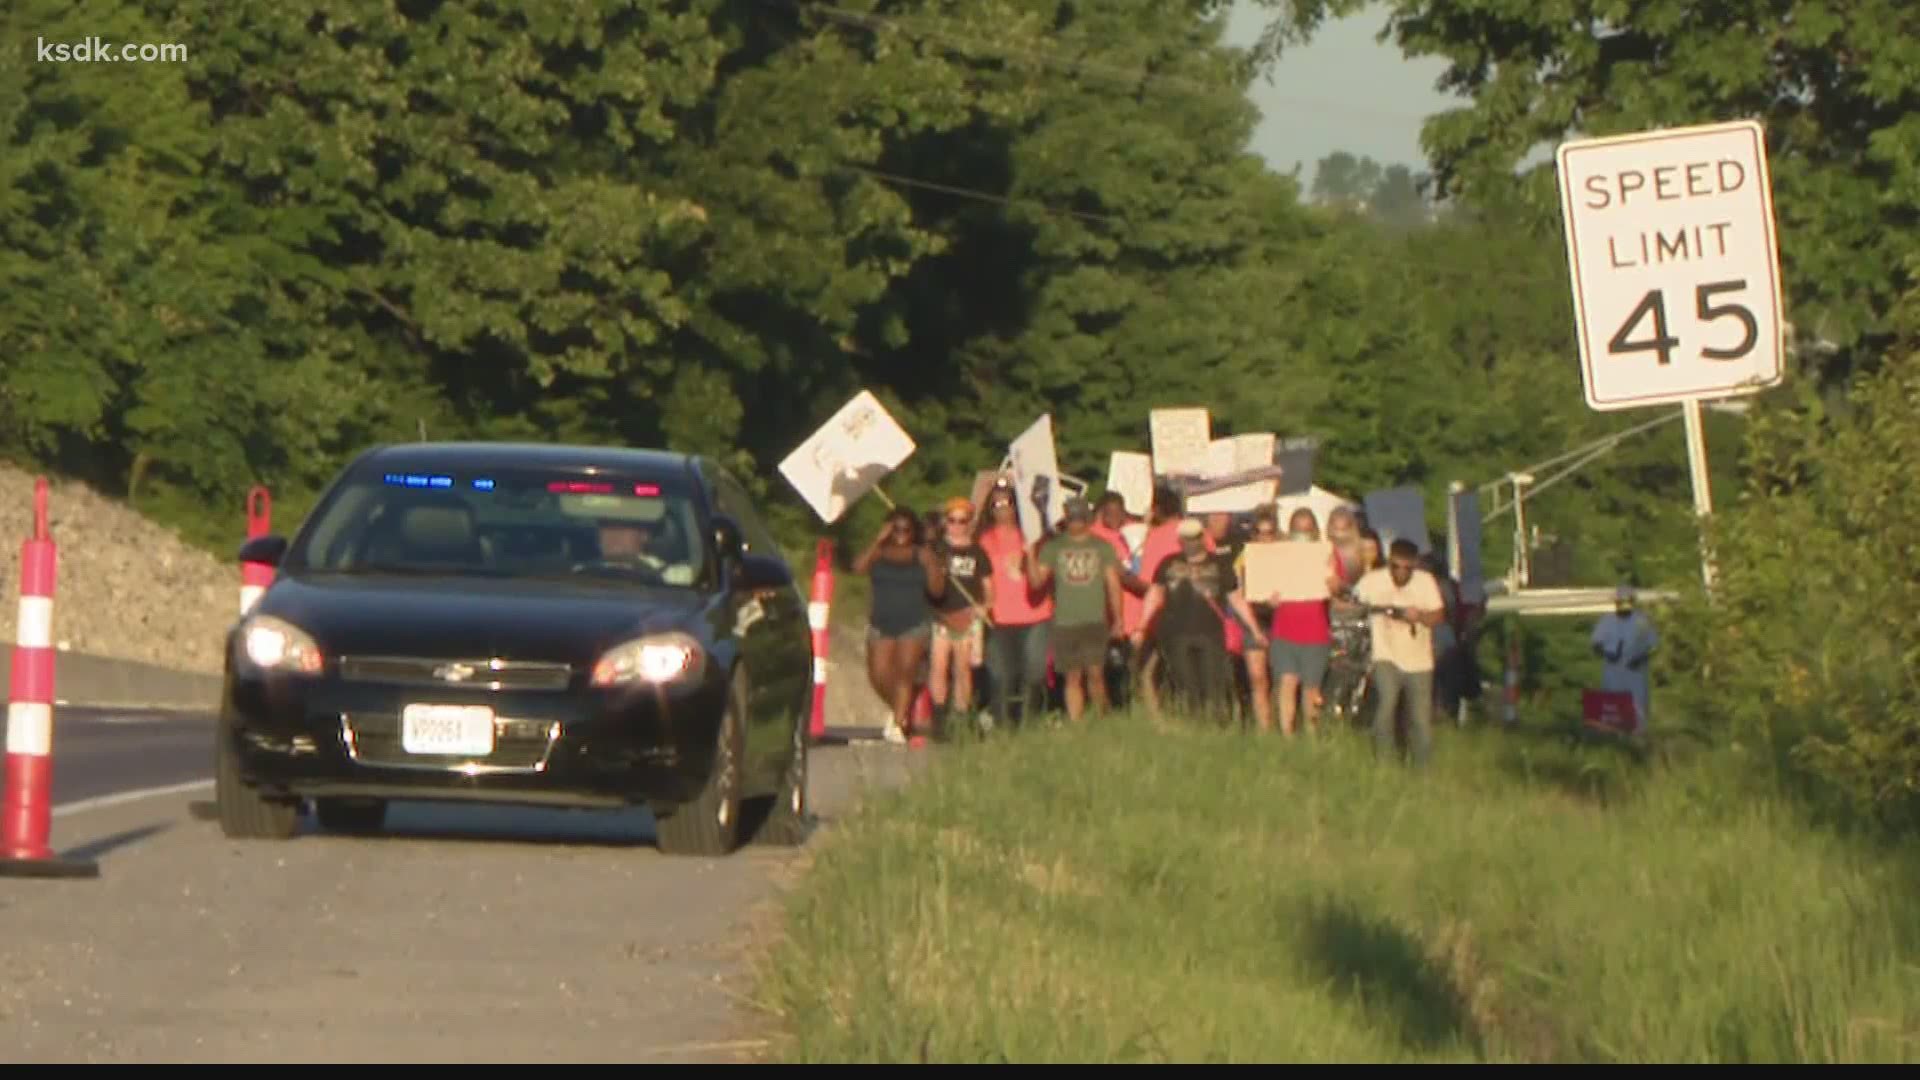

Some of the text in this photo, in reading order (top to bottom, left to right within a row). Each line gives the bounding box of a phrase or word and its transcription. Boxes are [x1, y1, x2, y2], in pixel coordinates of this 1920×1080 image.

[1584, 159, 1745, 210] SPEED
[1607, 222, 1732, 269] LIMIT
[1607, 279, 1759, 366] 45
